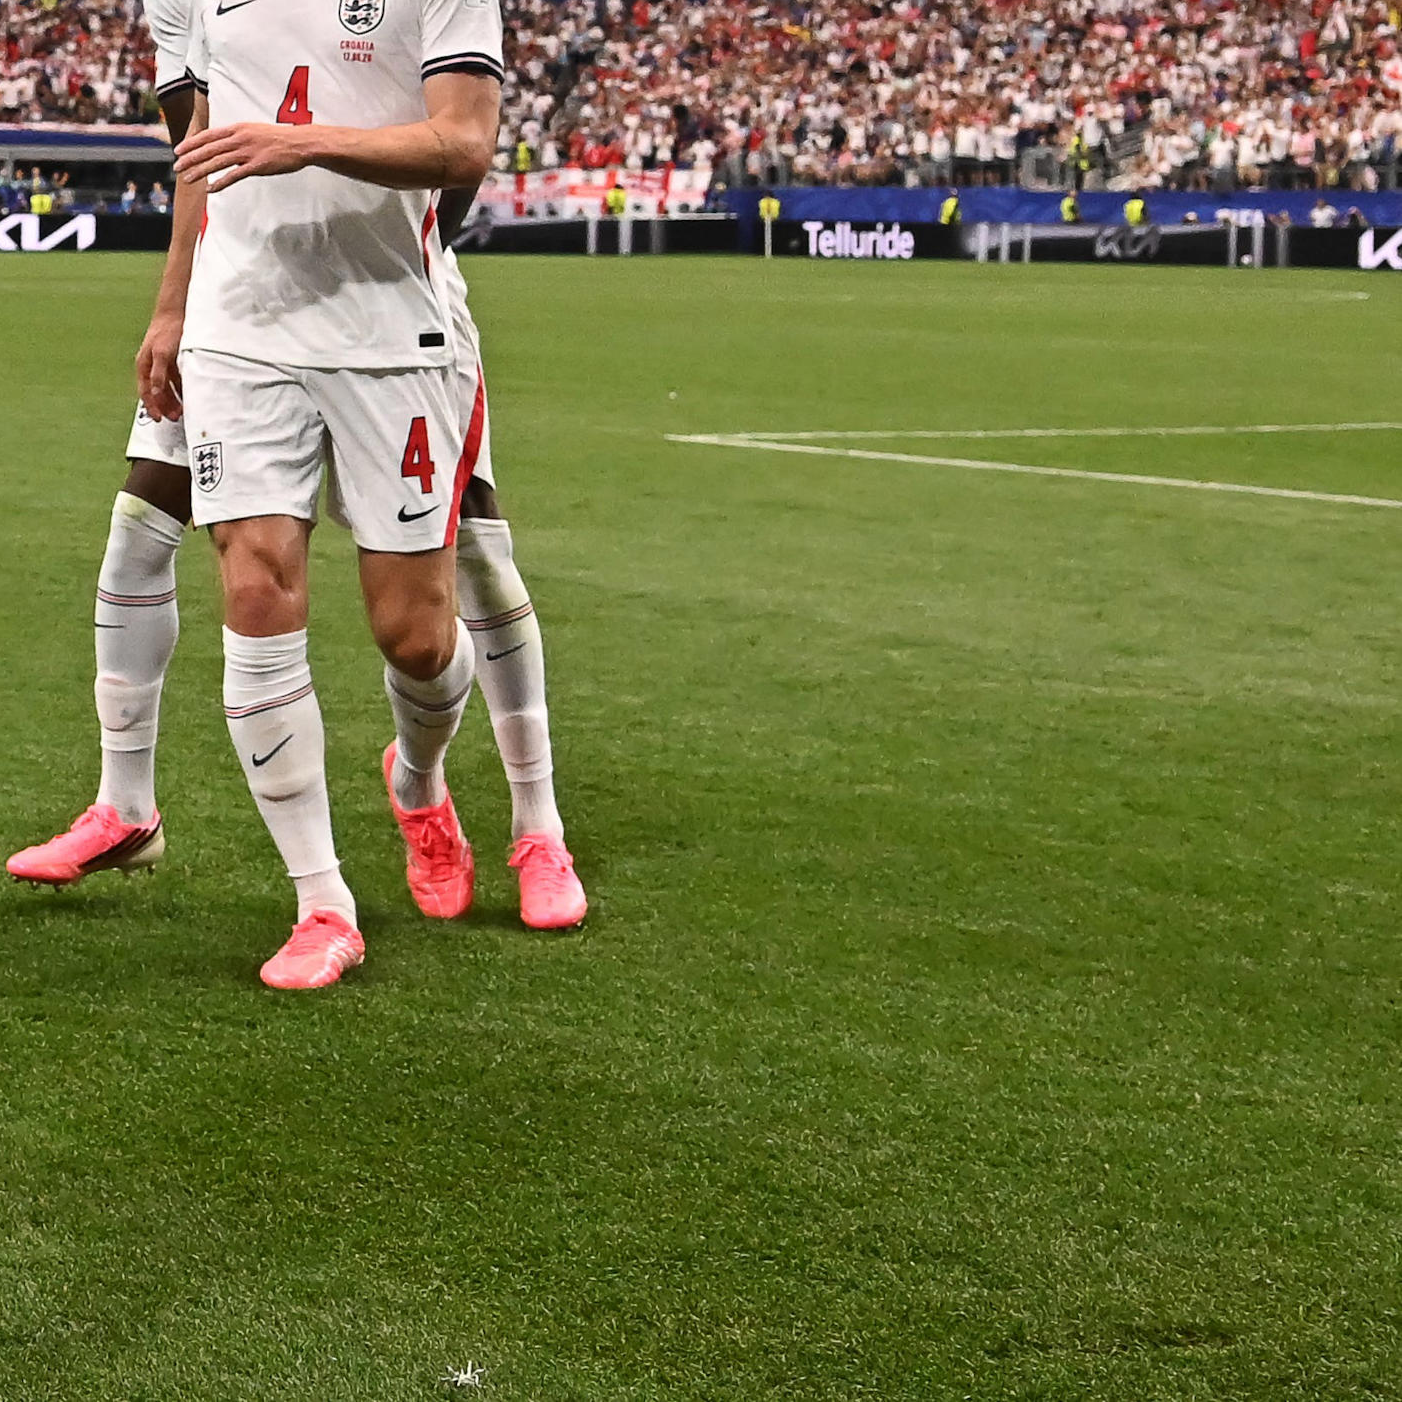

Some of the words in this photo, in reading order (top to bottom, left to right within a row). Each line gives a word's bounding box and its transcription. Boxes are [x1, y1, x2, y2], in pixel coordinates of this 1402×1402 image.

[340, 40, 375, 51] CROATIA
[276, 65, 314, 125] 4
[802, 220, 915, 260] Telluride
[401, 416, 436, 494] 4
